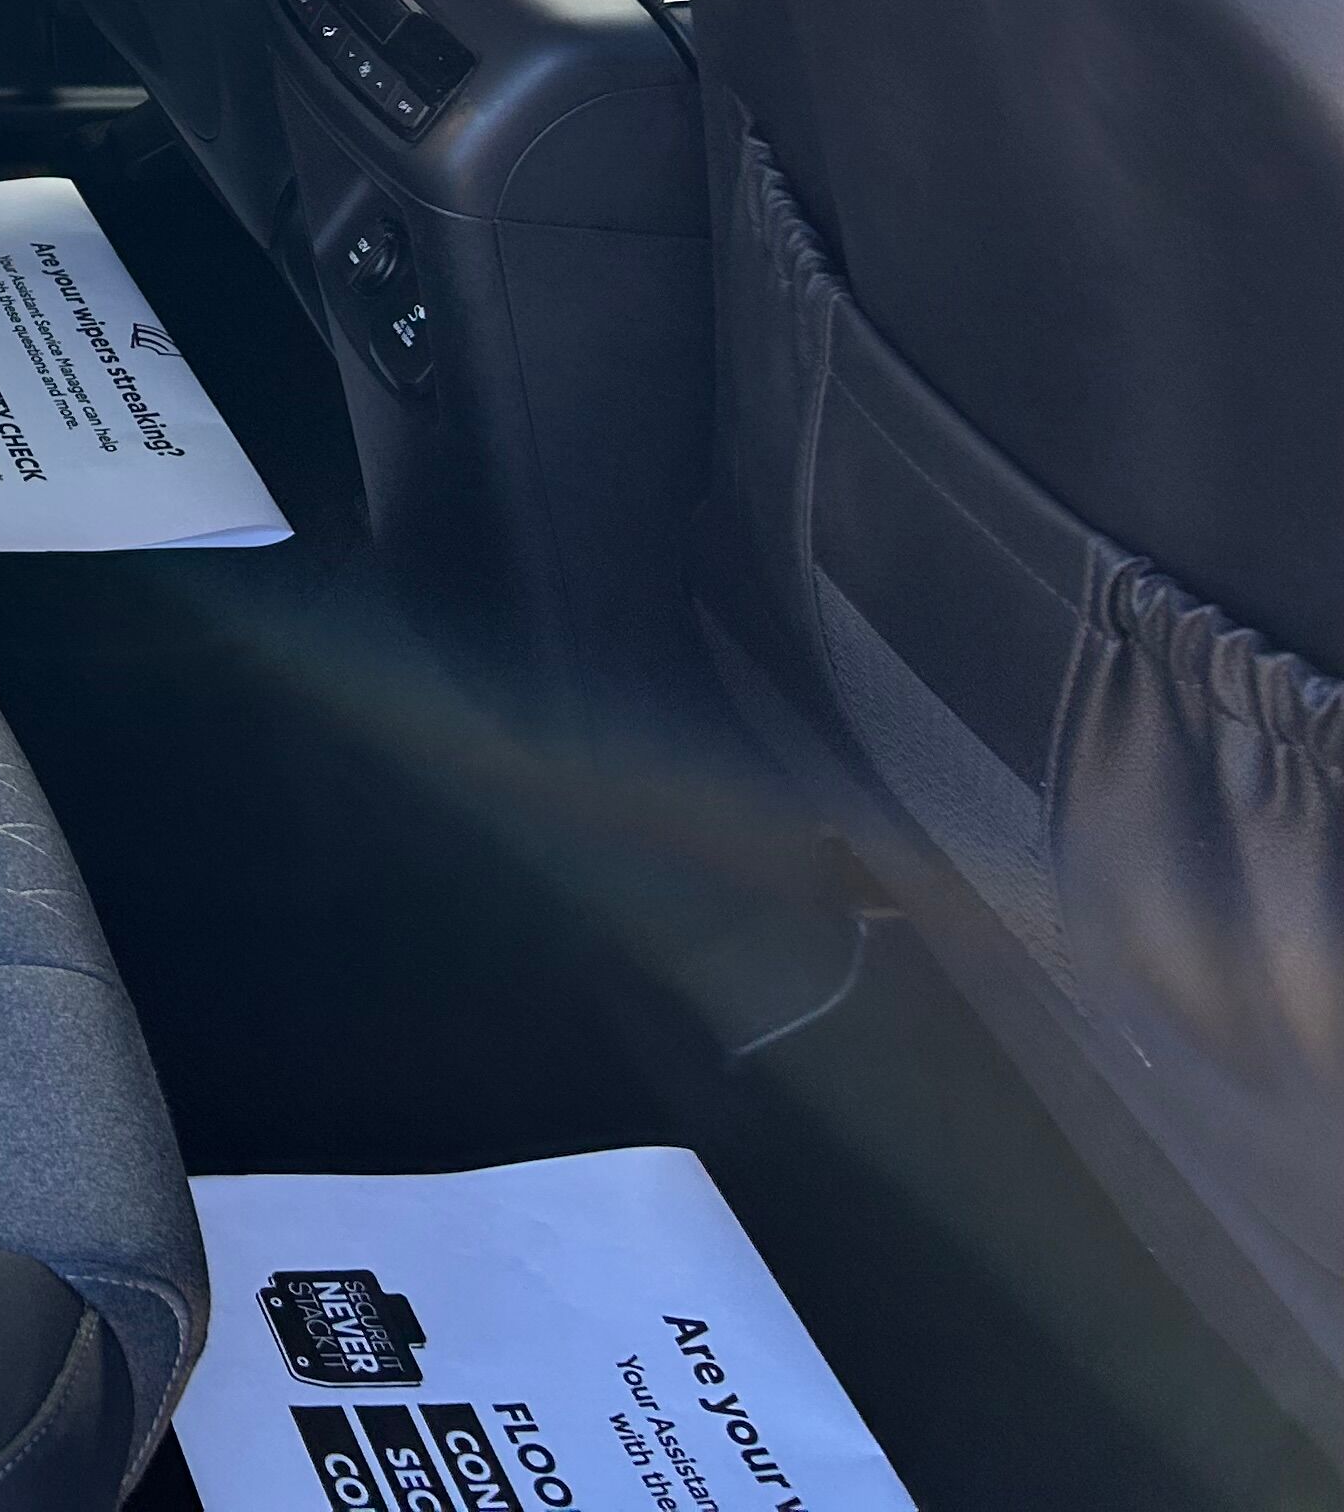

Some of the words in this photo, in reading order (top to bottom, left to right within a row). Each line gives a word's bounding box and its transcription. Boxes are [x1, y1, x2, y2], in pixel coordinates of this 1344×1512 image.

[30, 243, 59, 266] Are
[0, 296, 21, 322] these
[42, 269, 85, 304] your
[9, 275, 44, 318] Assistant
[34, 320, 62, 356] Service
[55, 358, 90, 403] Manager
[83, 407, 102, 425] can
[94, 428, 118, 452] help
[12, 325, 49, 374] questions
[73, 307, 119, 363] wipers
[42, 377, 67, 396] and
[54, 399, 78, 430] more.
[107, 368, 185, 456] streaking?
[288, 1281, 339, 1350] STACK
[319, 1353, 350, 1372] IT
[313, 1281, 379, 1374] NEVER
[344, 1280, 396, 1353] SECURE
[378, 1355, 405, 1372] IT
[616, 1354, 660, 1411] Your
[662, 1315, 725, 1385] Are
[698, 1392, 791, 1489] your
[492, 1402, 580, 1512] FLOO
[609, 1412, 654, 1466] with
[324, 1452, 376, 1512] CO
